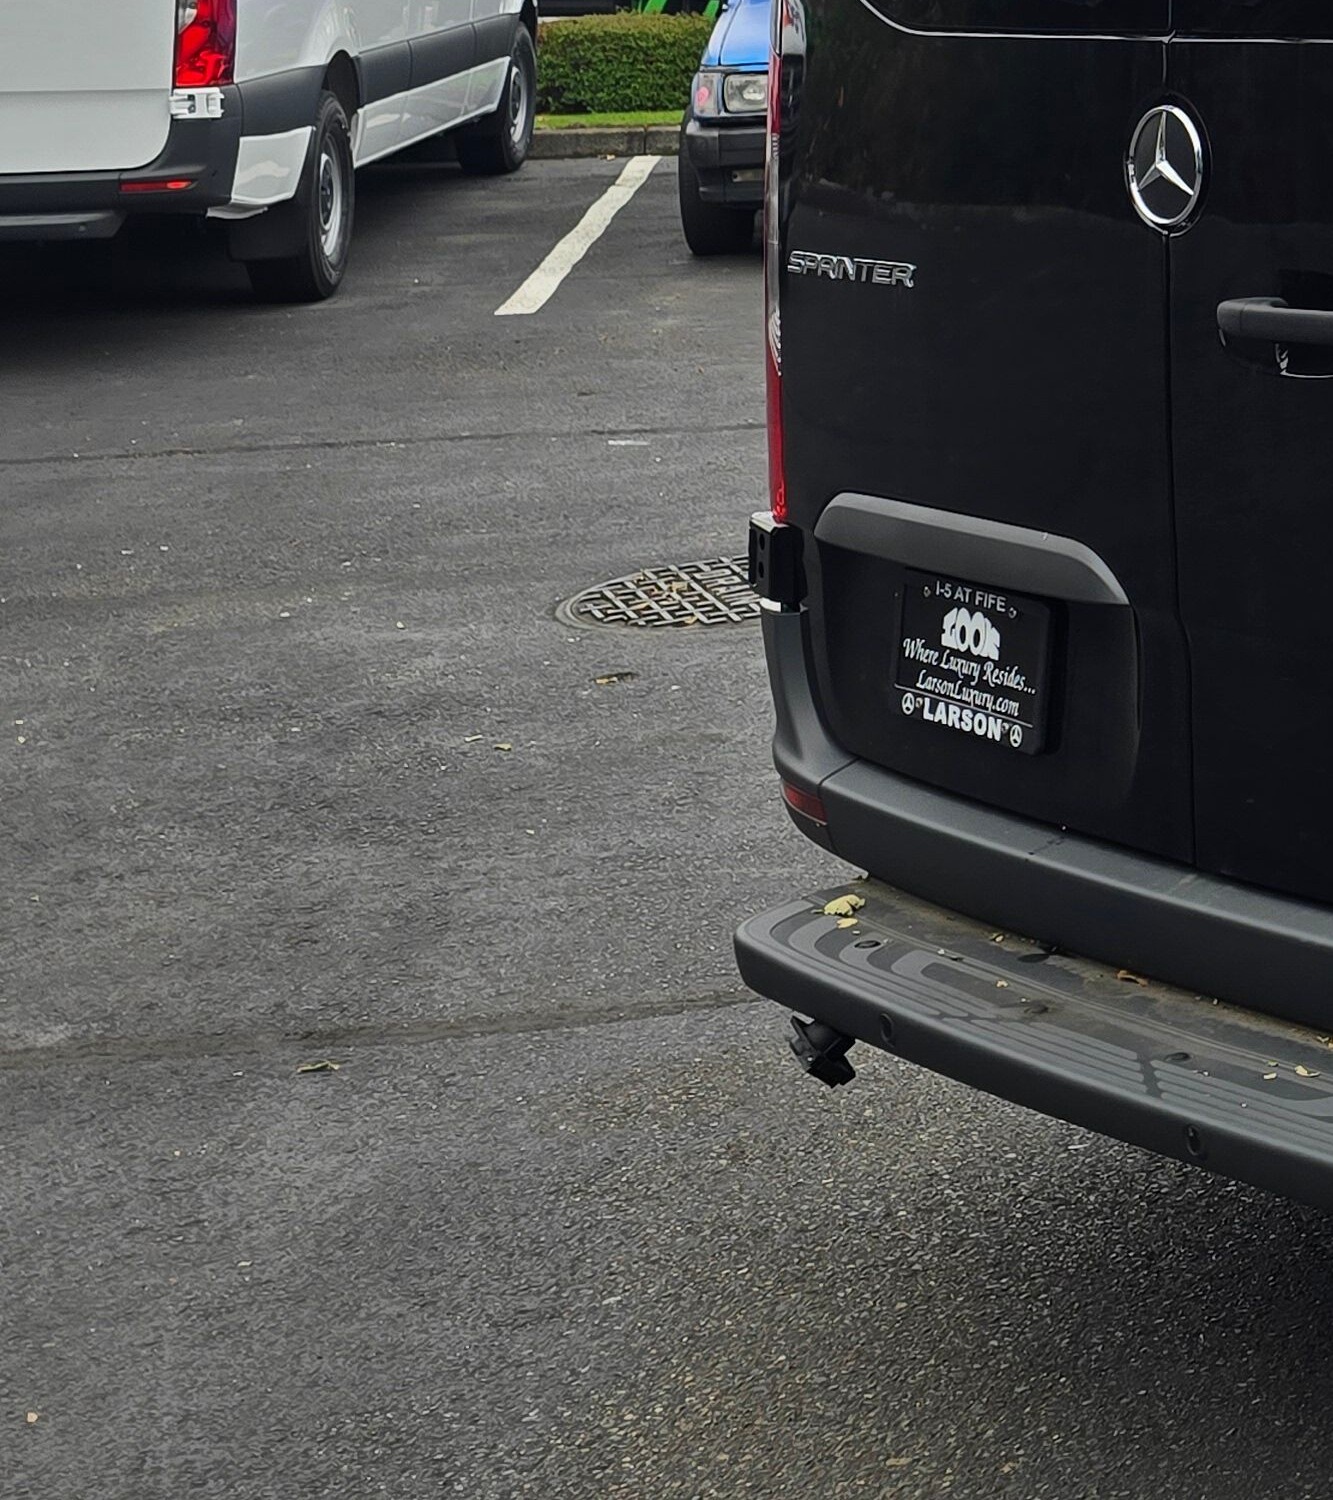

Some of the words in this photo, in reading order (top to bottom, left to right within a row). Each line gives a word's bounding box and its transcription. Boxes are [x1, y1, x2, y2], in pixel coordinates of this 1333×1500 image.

[787, 250, 917, 288] SPRINTER
[935, 580, 952, 599] I-5
[953, 587, 972, 604] AT
[975, 592, 1007, 612] FIFE
[903, 638, 939, 668] Where
[940, 649, 981, 686] Luxury
[983, 661, 1036, 695] Resides...
[916, 669, 1020, 717] LarsonLuxury.com
[922, 697, 1003, 742] LARSON
